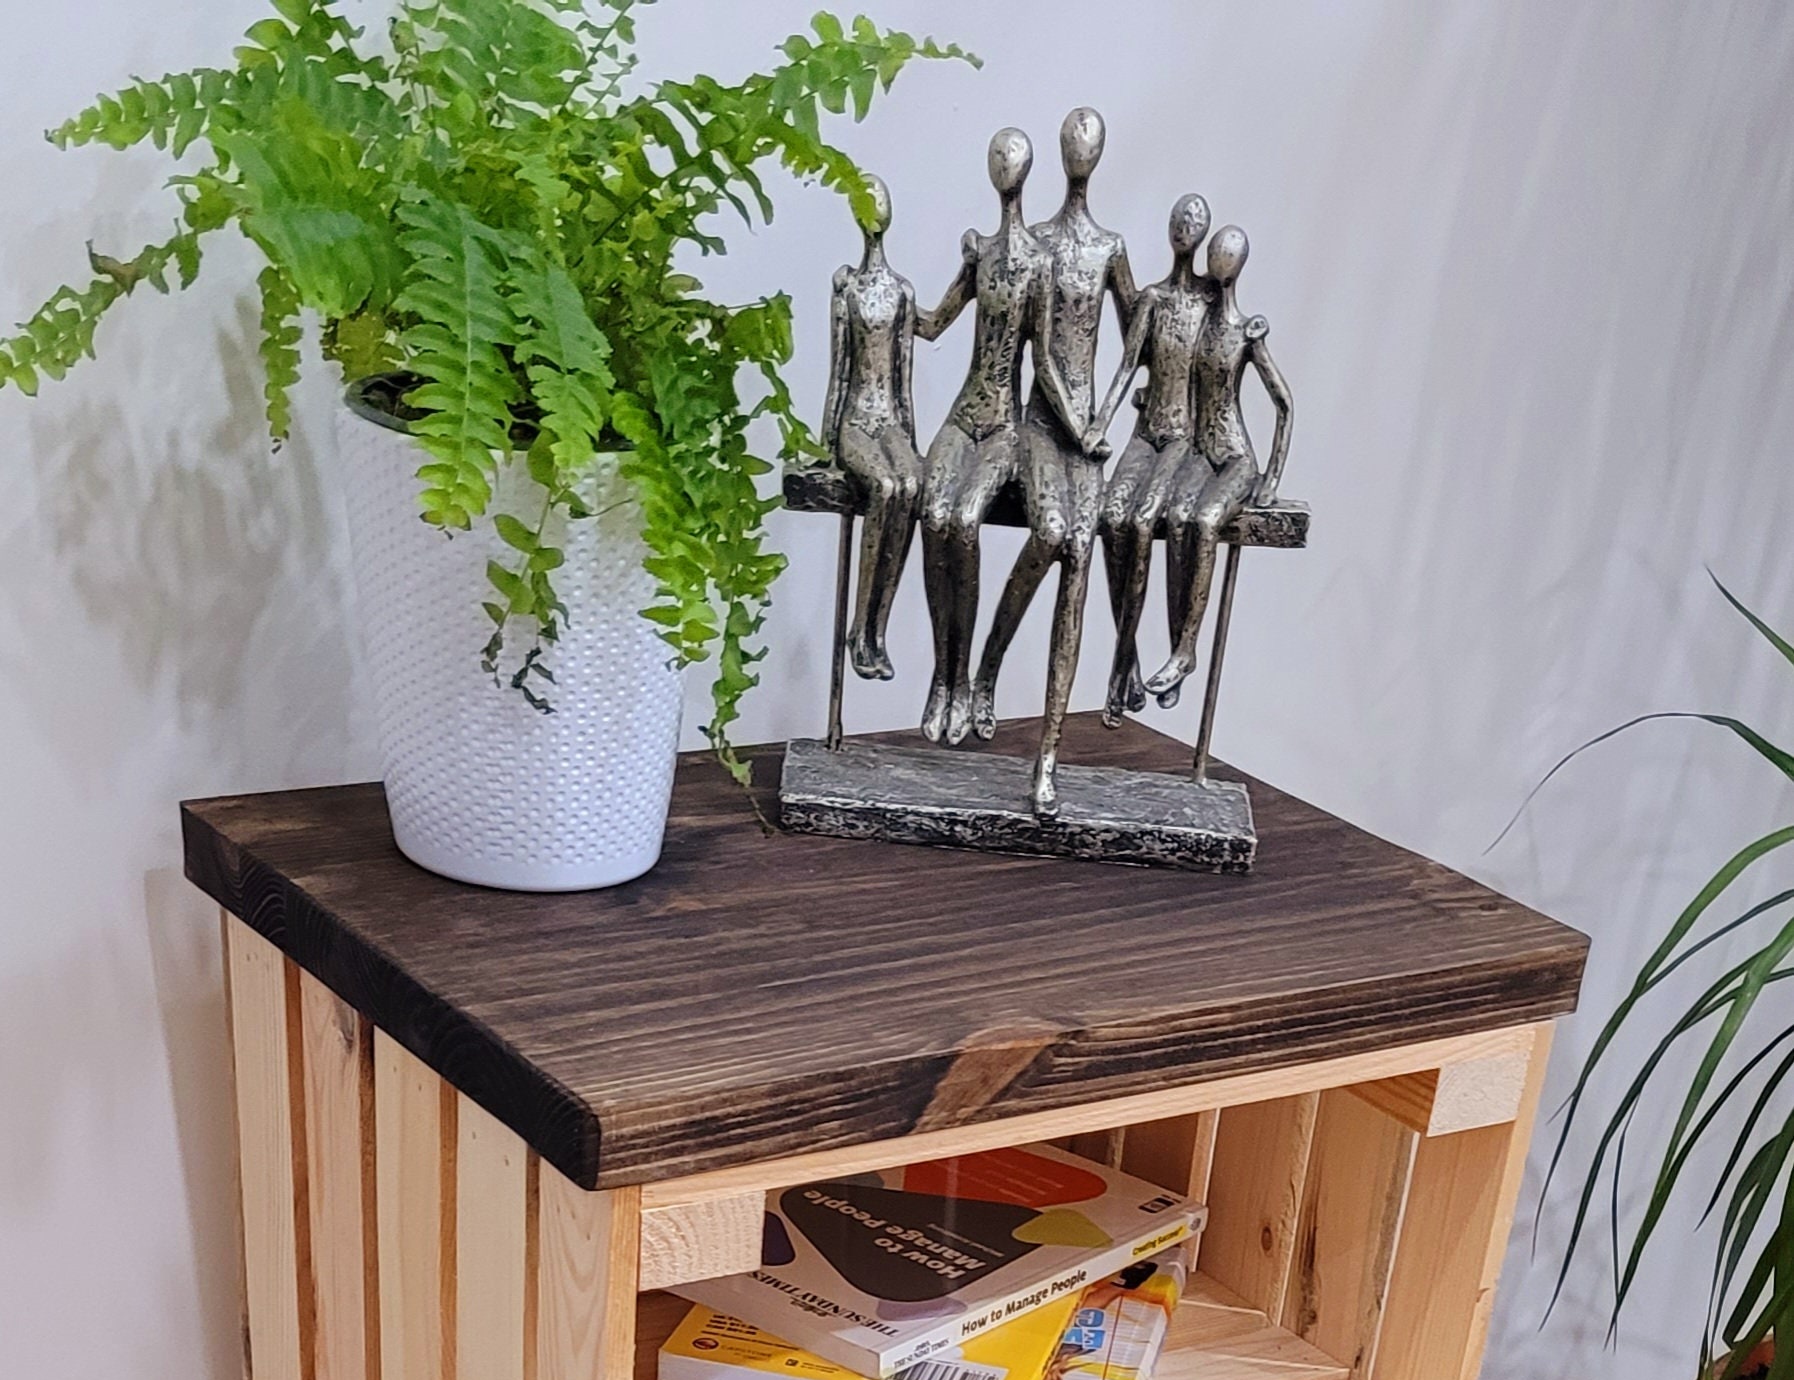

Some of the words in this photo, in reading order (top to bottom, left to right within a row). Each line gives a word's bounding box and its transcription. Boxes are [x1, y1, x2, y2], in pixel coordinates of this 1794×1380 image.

[803, 1190, 888, 1229] People
[873, 1237, 904, 1254] to
[885, 1225, 987, 1270] Manage
[902, 1250, 967, 1280] How
[747, 1271, 801, 1296] TIMES
[797, 1291, 867, 1323] SUNDAY
[962, 1315, 988, 1336] How
[991, 1309, 1003, 1323] to
[1004, 1288, 1049, 1316] Manage
[1051, 1269, 1087, 1295] People
[861, 1319, 899, 1338] THE
